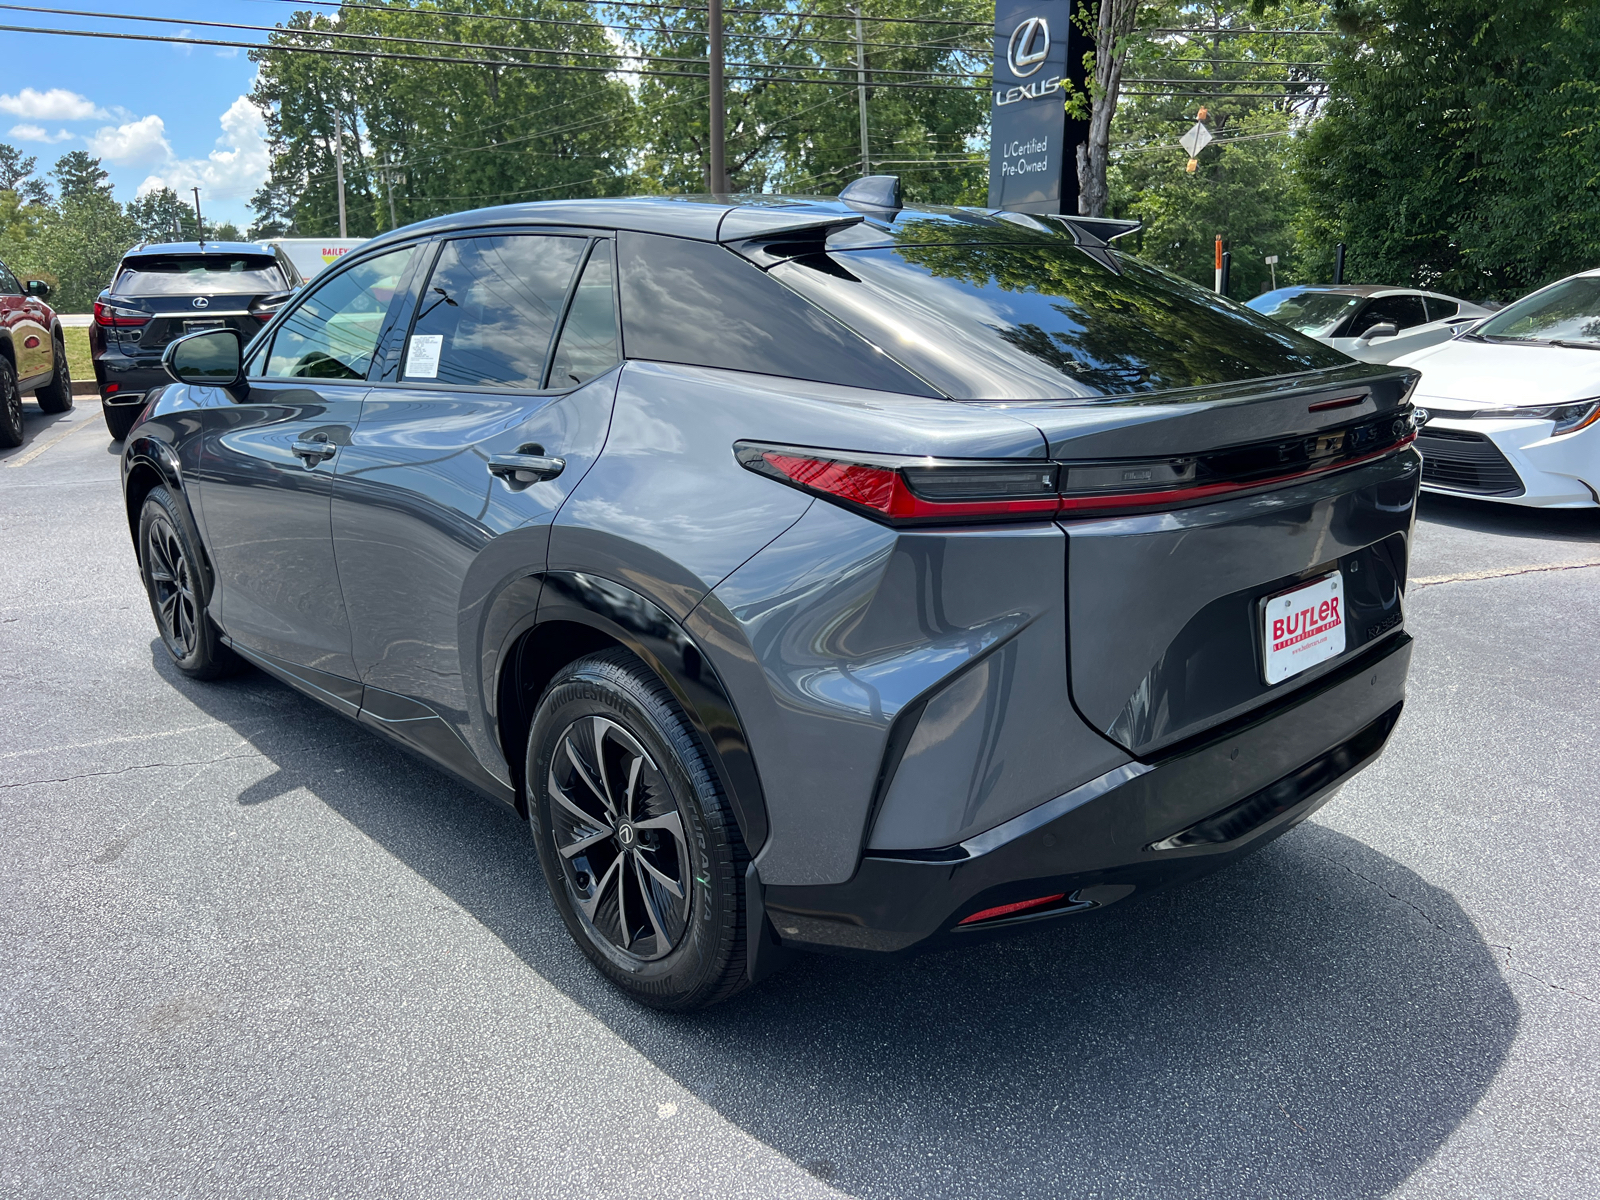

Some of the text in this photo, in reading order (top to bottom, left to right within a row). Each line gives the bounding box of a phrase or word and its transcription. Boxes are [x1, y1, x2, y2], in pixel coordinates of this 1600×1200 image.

[996, 76, 1060, 106] LEXUS
[1003, 136, 1048, 158] L/Certified
[1001, 155, 1048, 177] Pre-Owned
[322, 248, 353, 256] BAILEY
[1273, 618, 1341, 651] AUTOMOTIVE GROUP
[686, 802, 713, 921] TURANZA
